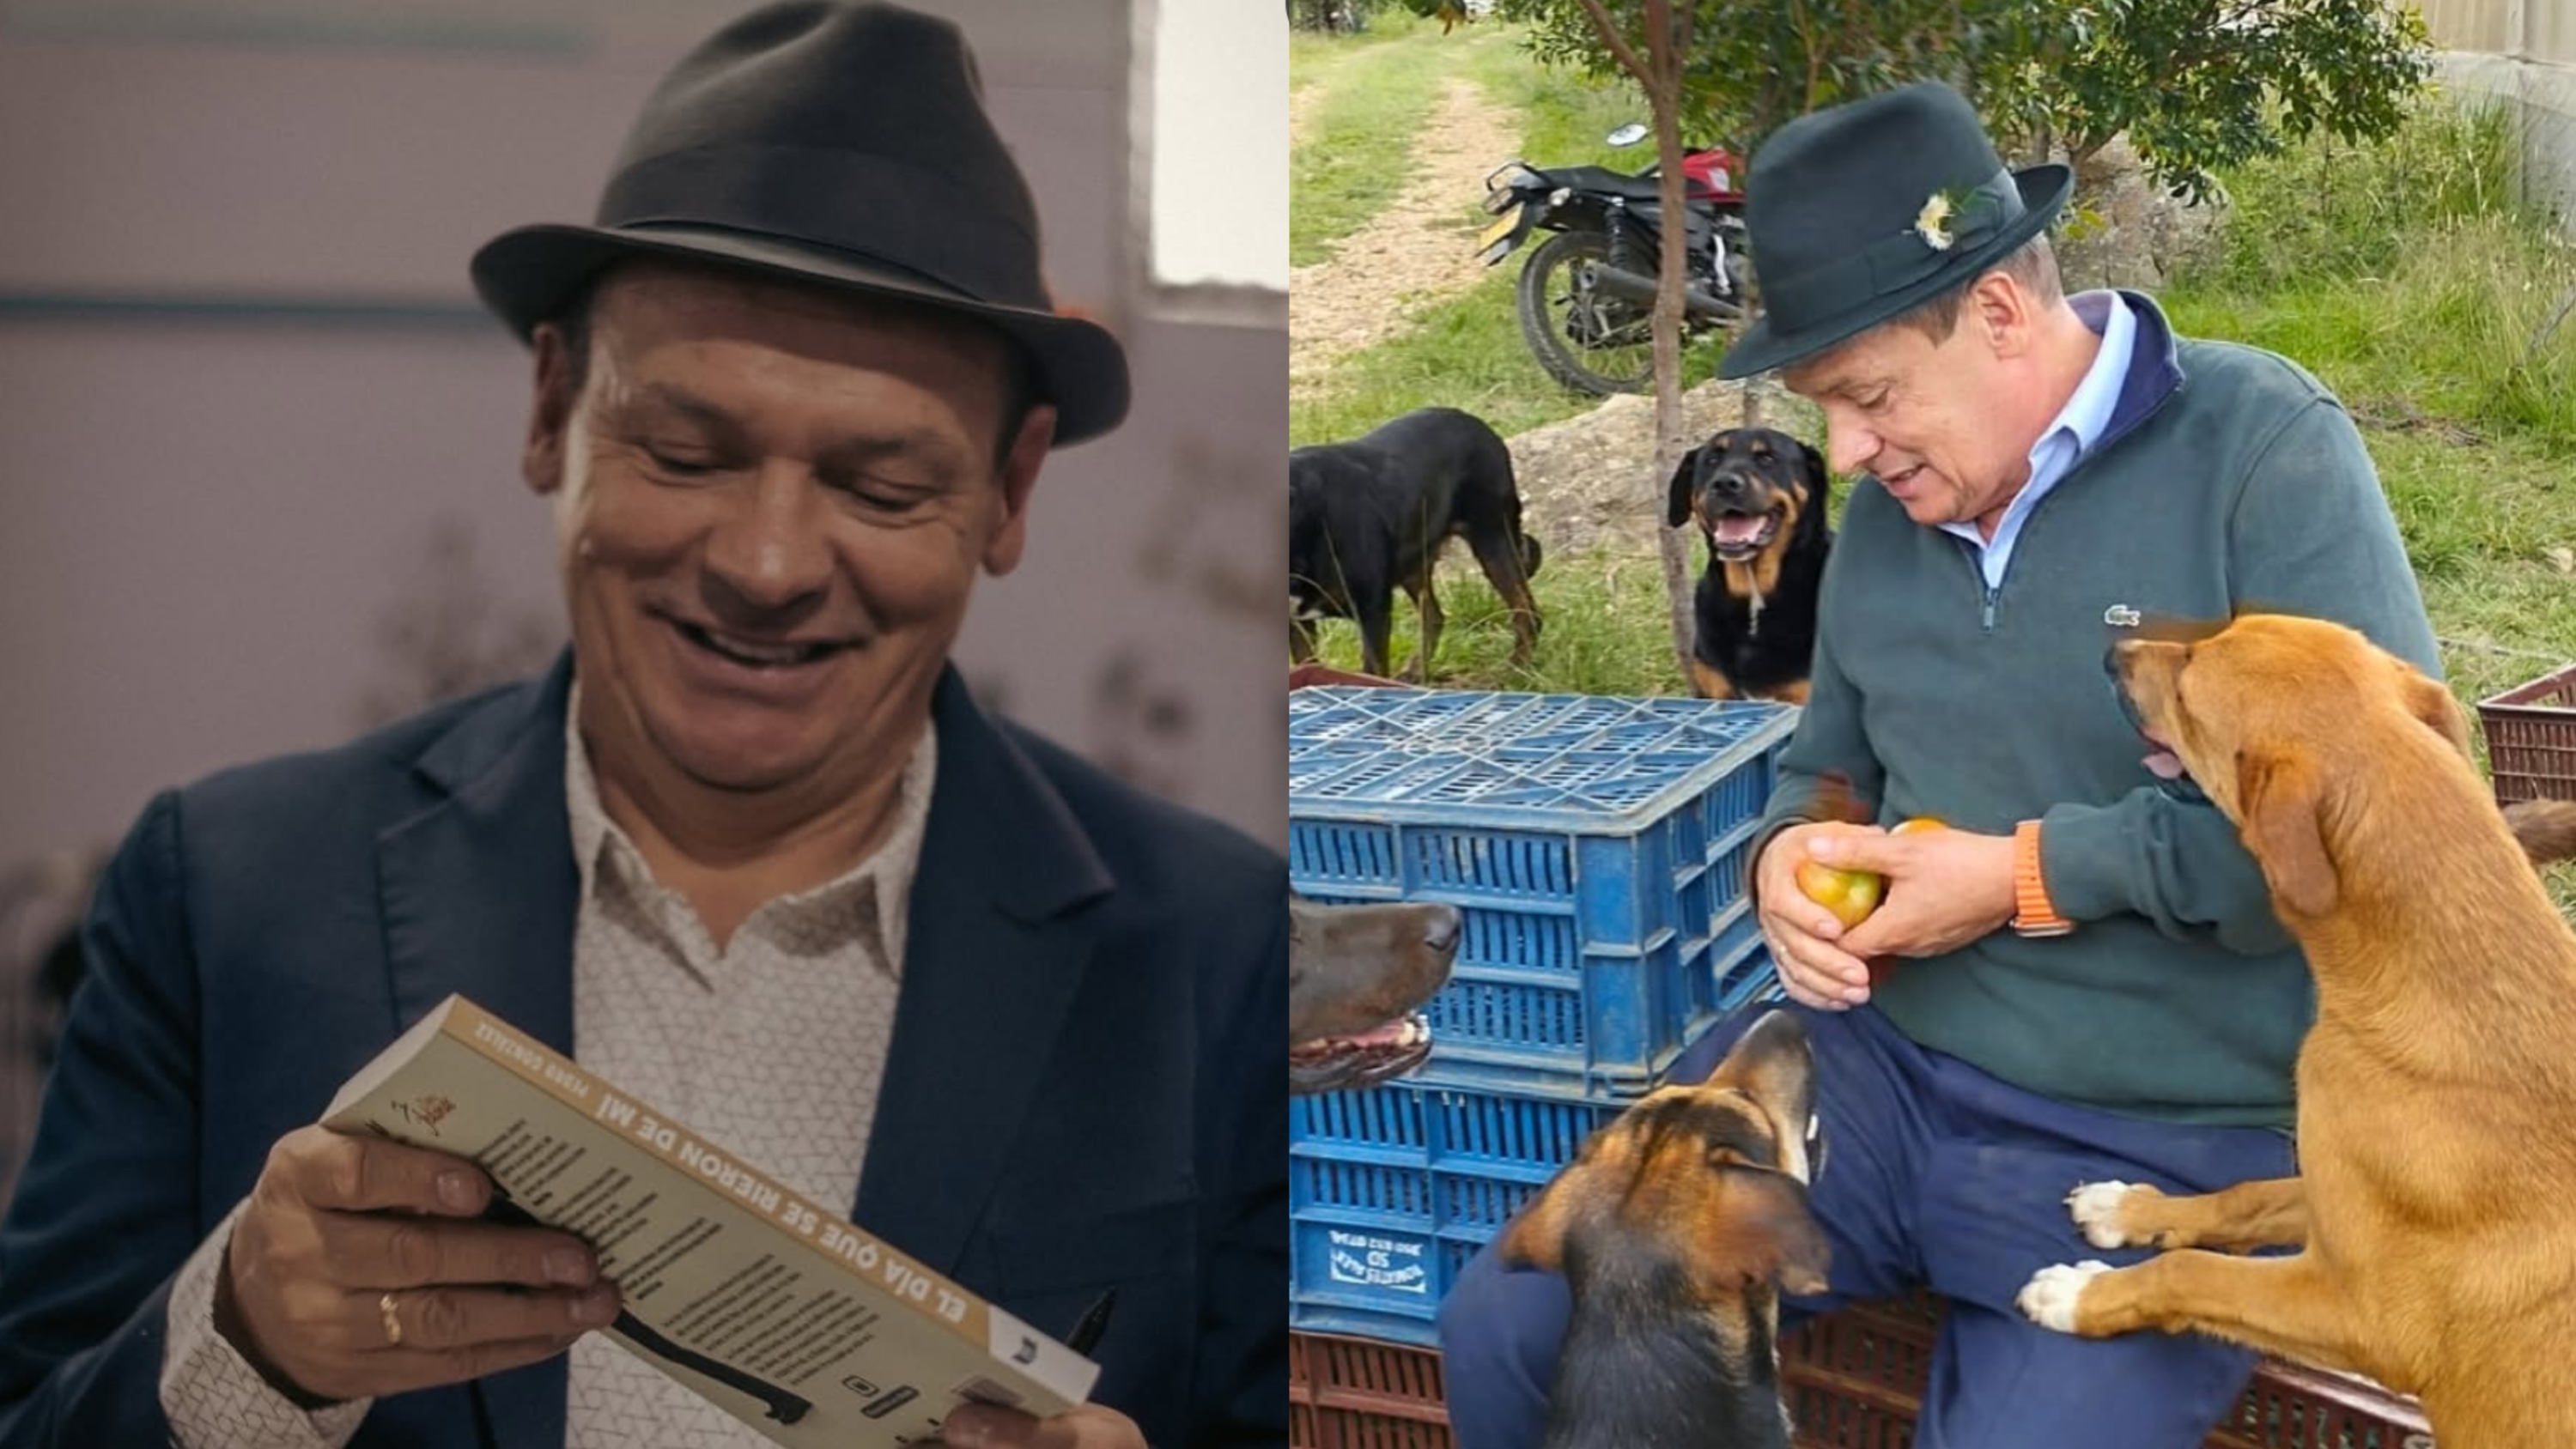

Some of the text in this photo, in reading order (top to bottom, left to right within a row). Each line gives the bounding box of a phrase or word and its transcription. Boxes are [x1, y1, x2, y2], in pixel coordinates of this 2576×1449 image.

[545, 1064, 588, 1097] PEDRO
[597, 1094, 966, 1322] EL DÍA QUE SE RIERON DE MÍ
